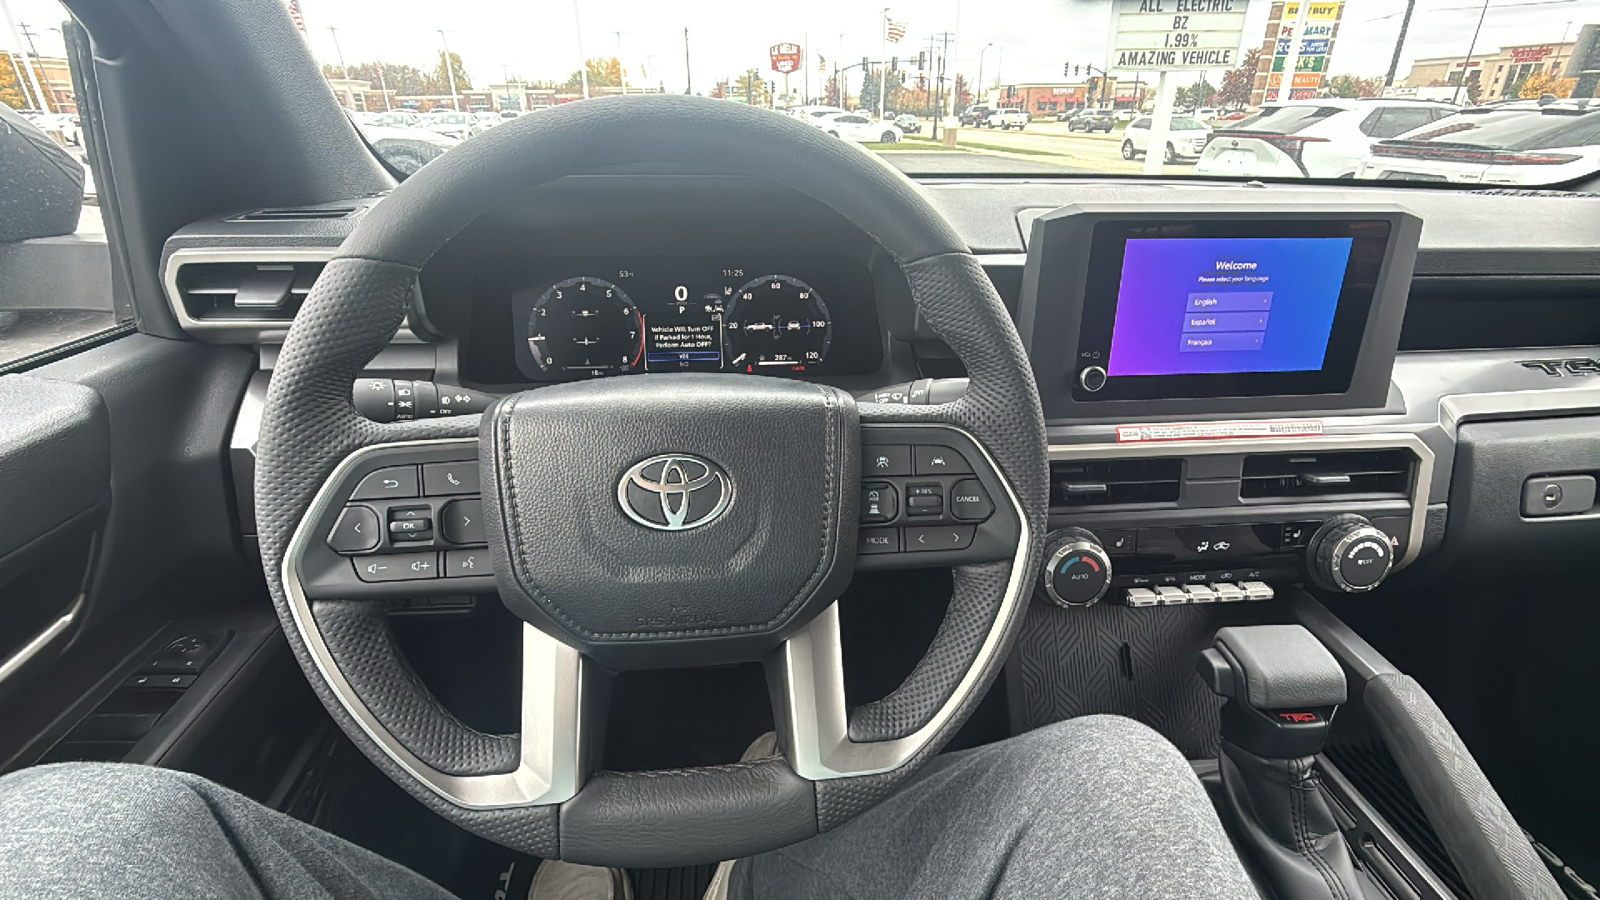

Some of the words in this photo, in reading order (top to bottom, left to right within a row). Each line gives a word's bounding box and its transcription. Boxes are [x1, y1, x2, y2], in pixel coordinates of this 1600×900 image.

[1139, 0, 1163, 13] ALL
[1176, 0, 1233, 13] ELECTRIC
[1312, 7, 1335, 15] BUY
[1164, 33, 1199, 48] 1.99%
[1118, 51, 1176, 66] AMAZING
[1182, 50, 1231, 65] VEHICLE
[1294, 76, 1318, 84] BEAUTY
[1215, 260, 1257, 271] Welcome
[723, 269, 744, 277] 11:25
[1216, 275, 1232, 283] select
[1244, 275, 1269, 283] language
[580, 284, 586, 292] 4
[556, 291, 563, 299] 3
[674, 286, 688, 301] 0
[1194, 298, 1218, 307] English
[679, 306, 686, 314] P
[1191, 318, 1216, 327] Español
[1187, 339, 1213, 347] Français
[805, 351, 819, 359] 120
[546, 357, 553, 365] 0
[866, 536, 889, 545] MODE
[1071, 573, 1089, 581] AUTO
